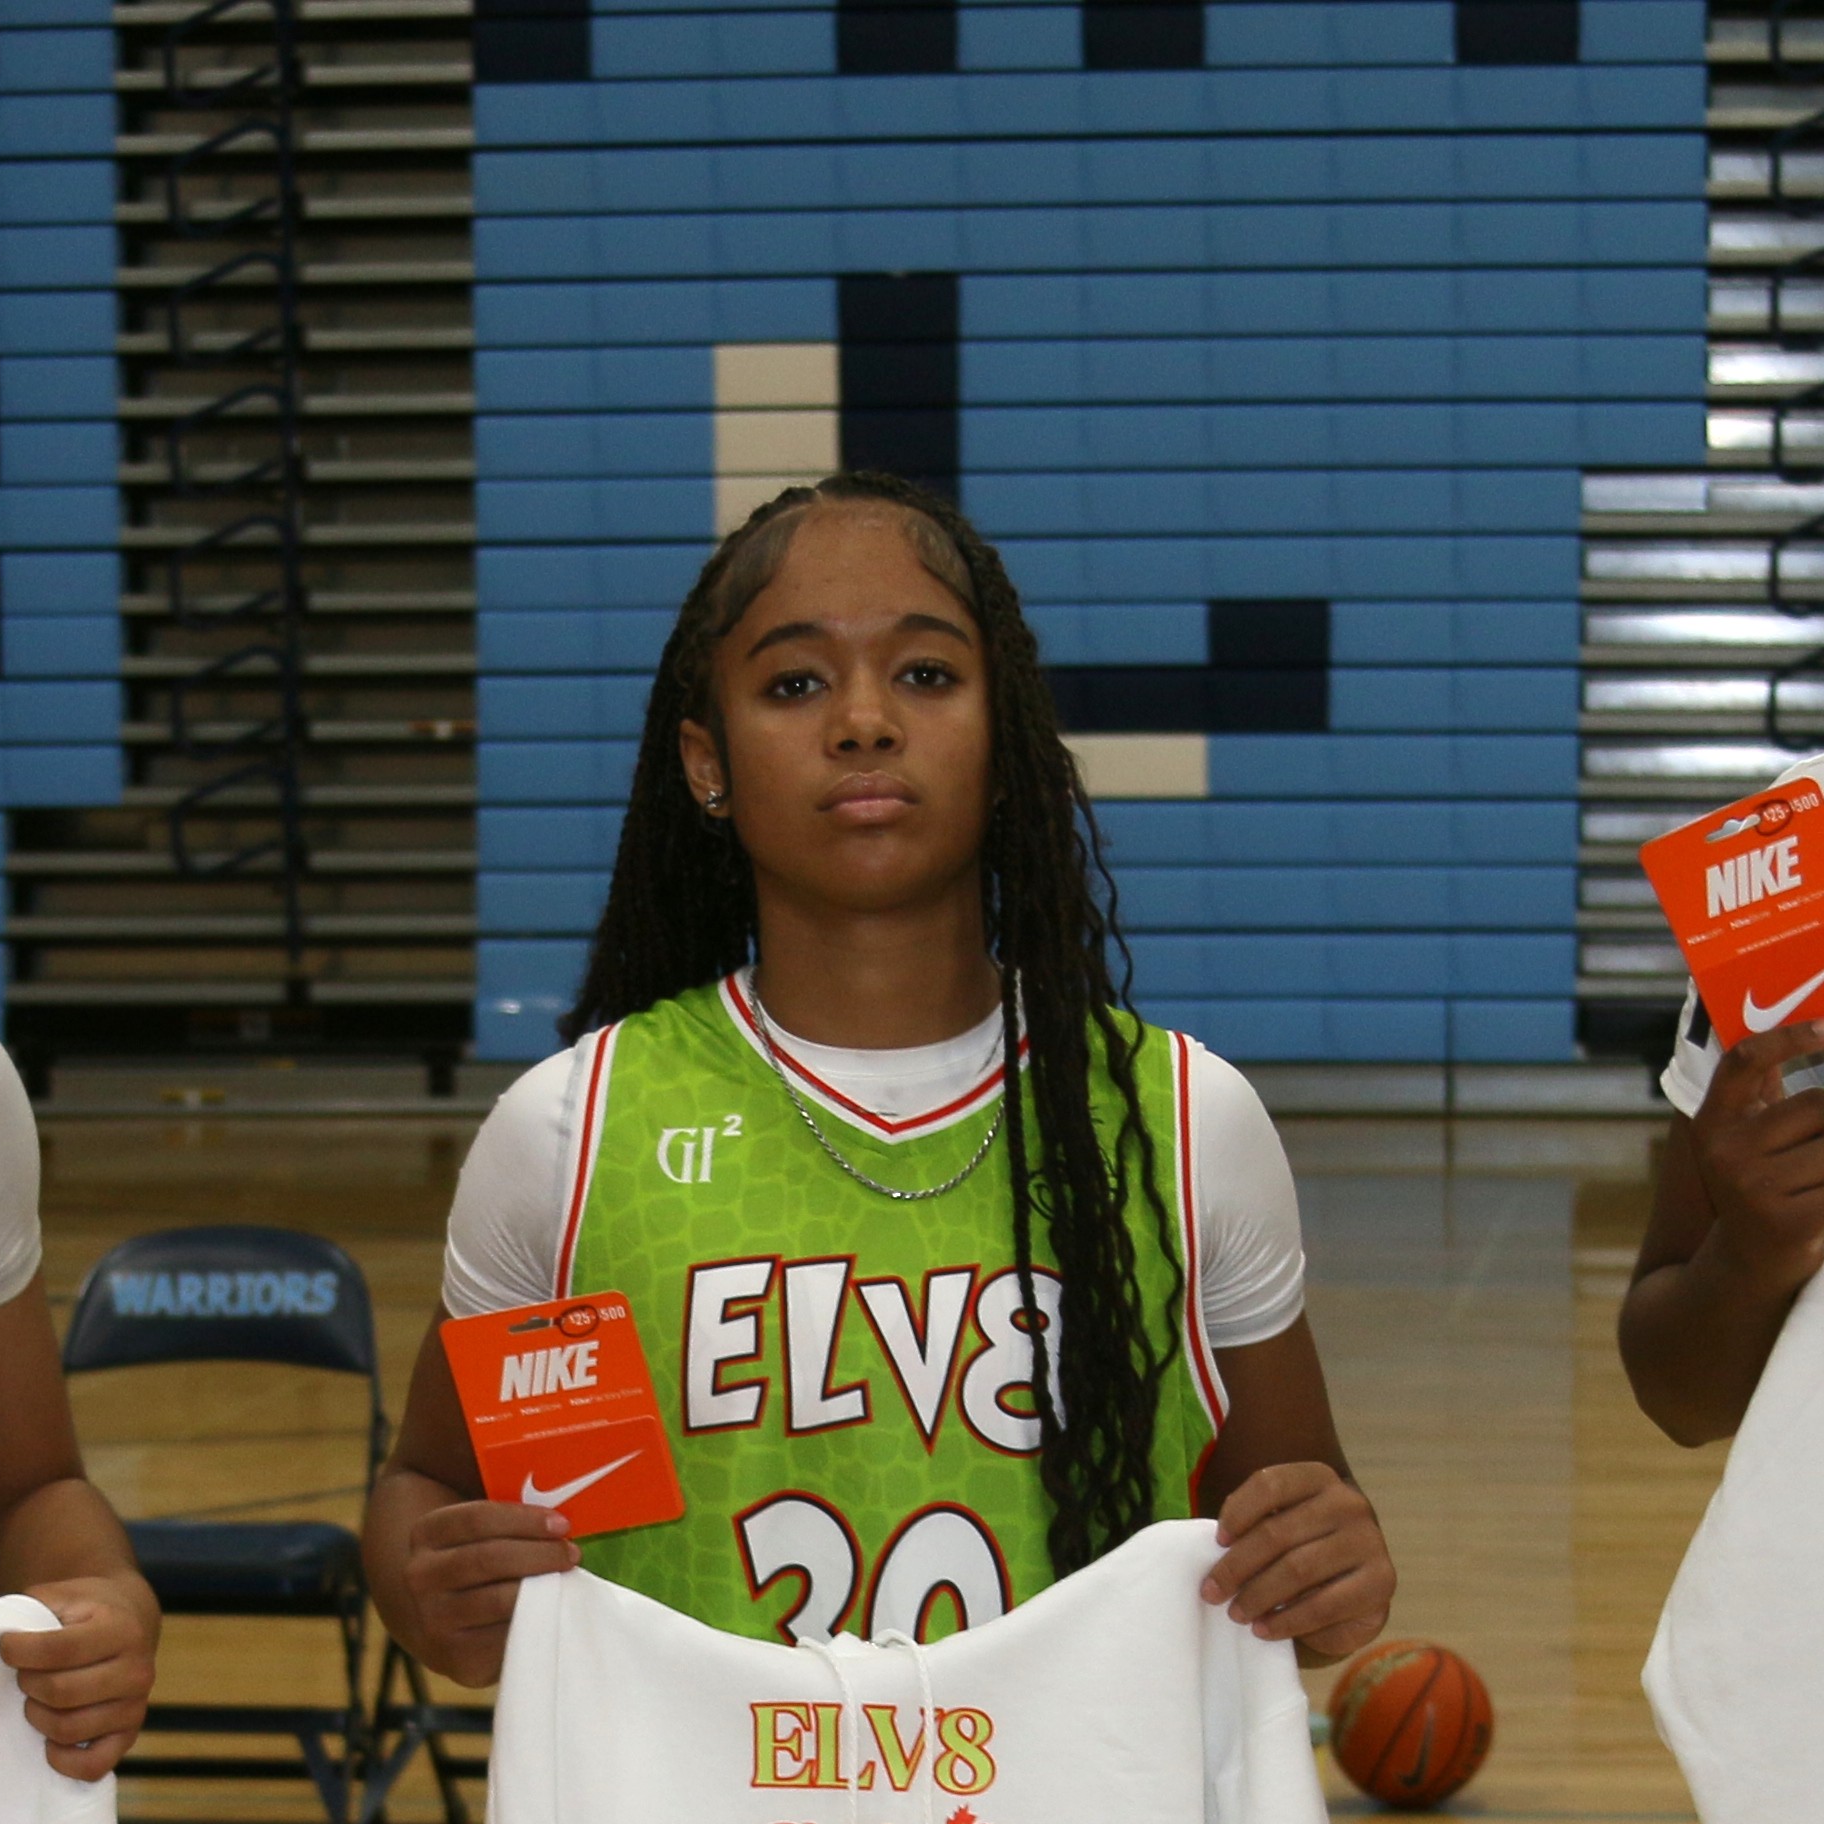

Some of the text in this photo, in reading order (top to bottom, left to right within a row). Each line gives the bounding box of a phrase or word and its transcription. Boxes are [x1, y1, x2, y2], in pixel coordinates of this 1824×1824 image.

[1705, 834, 1802, 918] NIKE
[109, 1270, 339, 1317] WARRIORS
[499, 1340, 600, 1403] NIKE
[681, 1254, 1069, 1458] ELV8
[749, 1701, 997, 1796] ELV8
